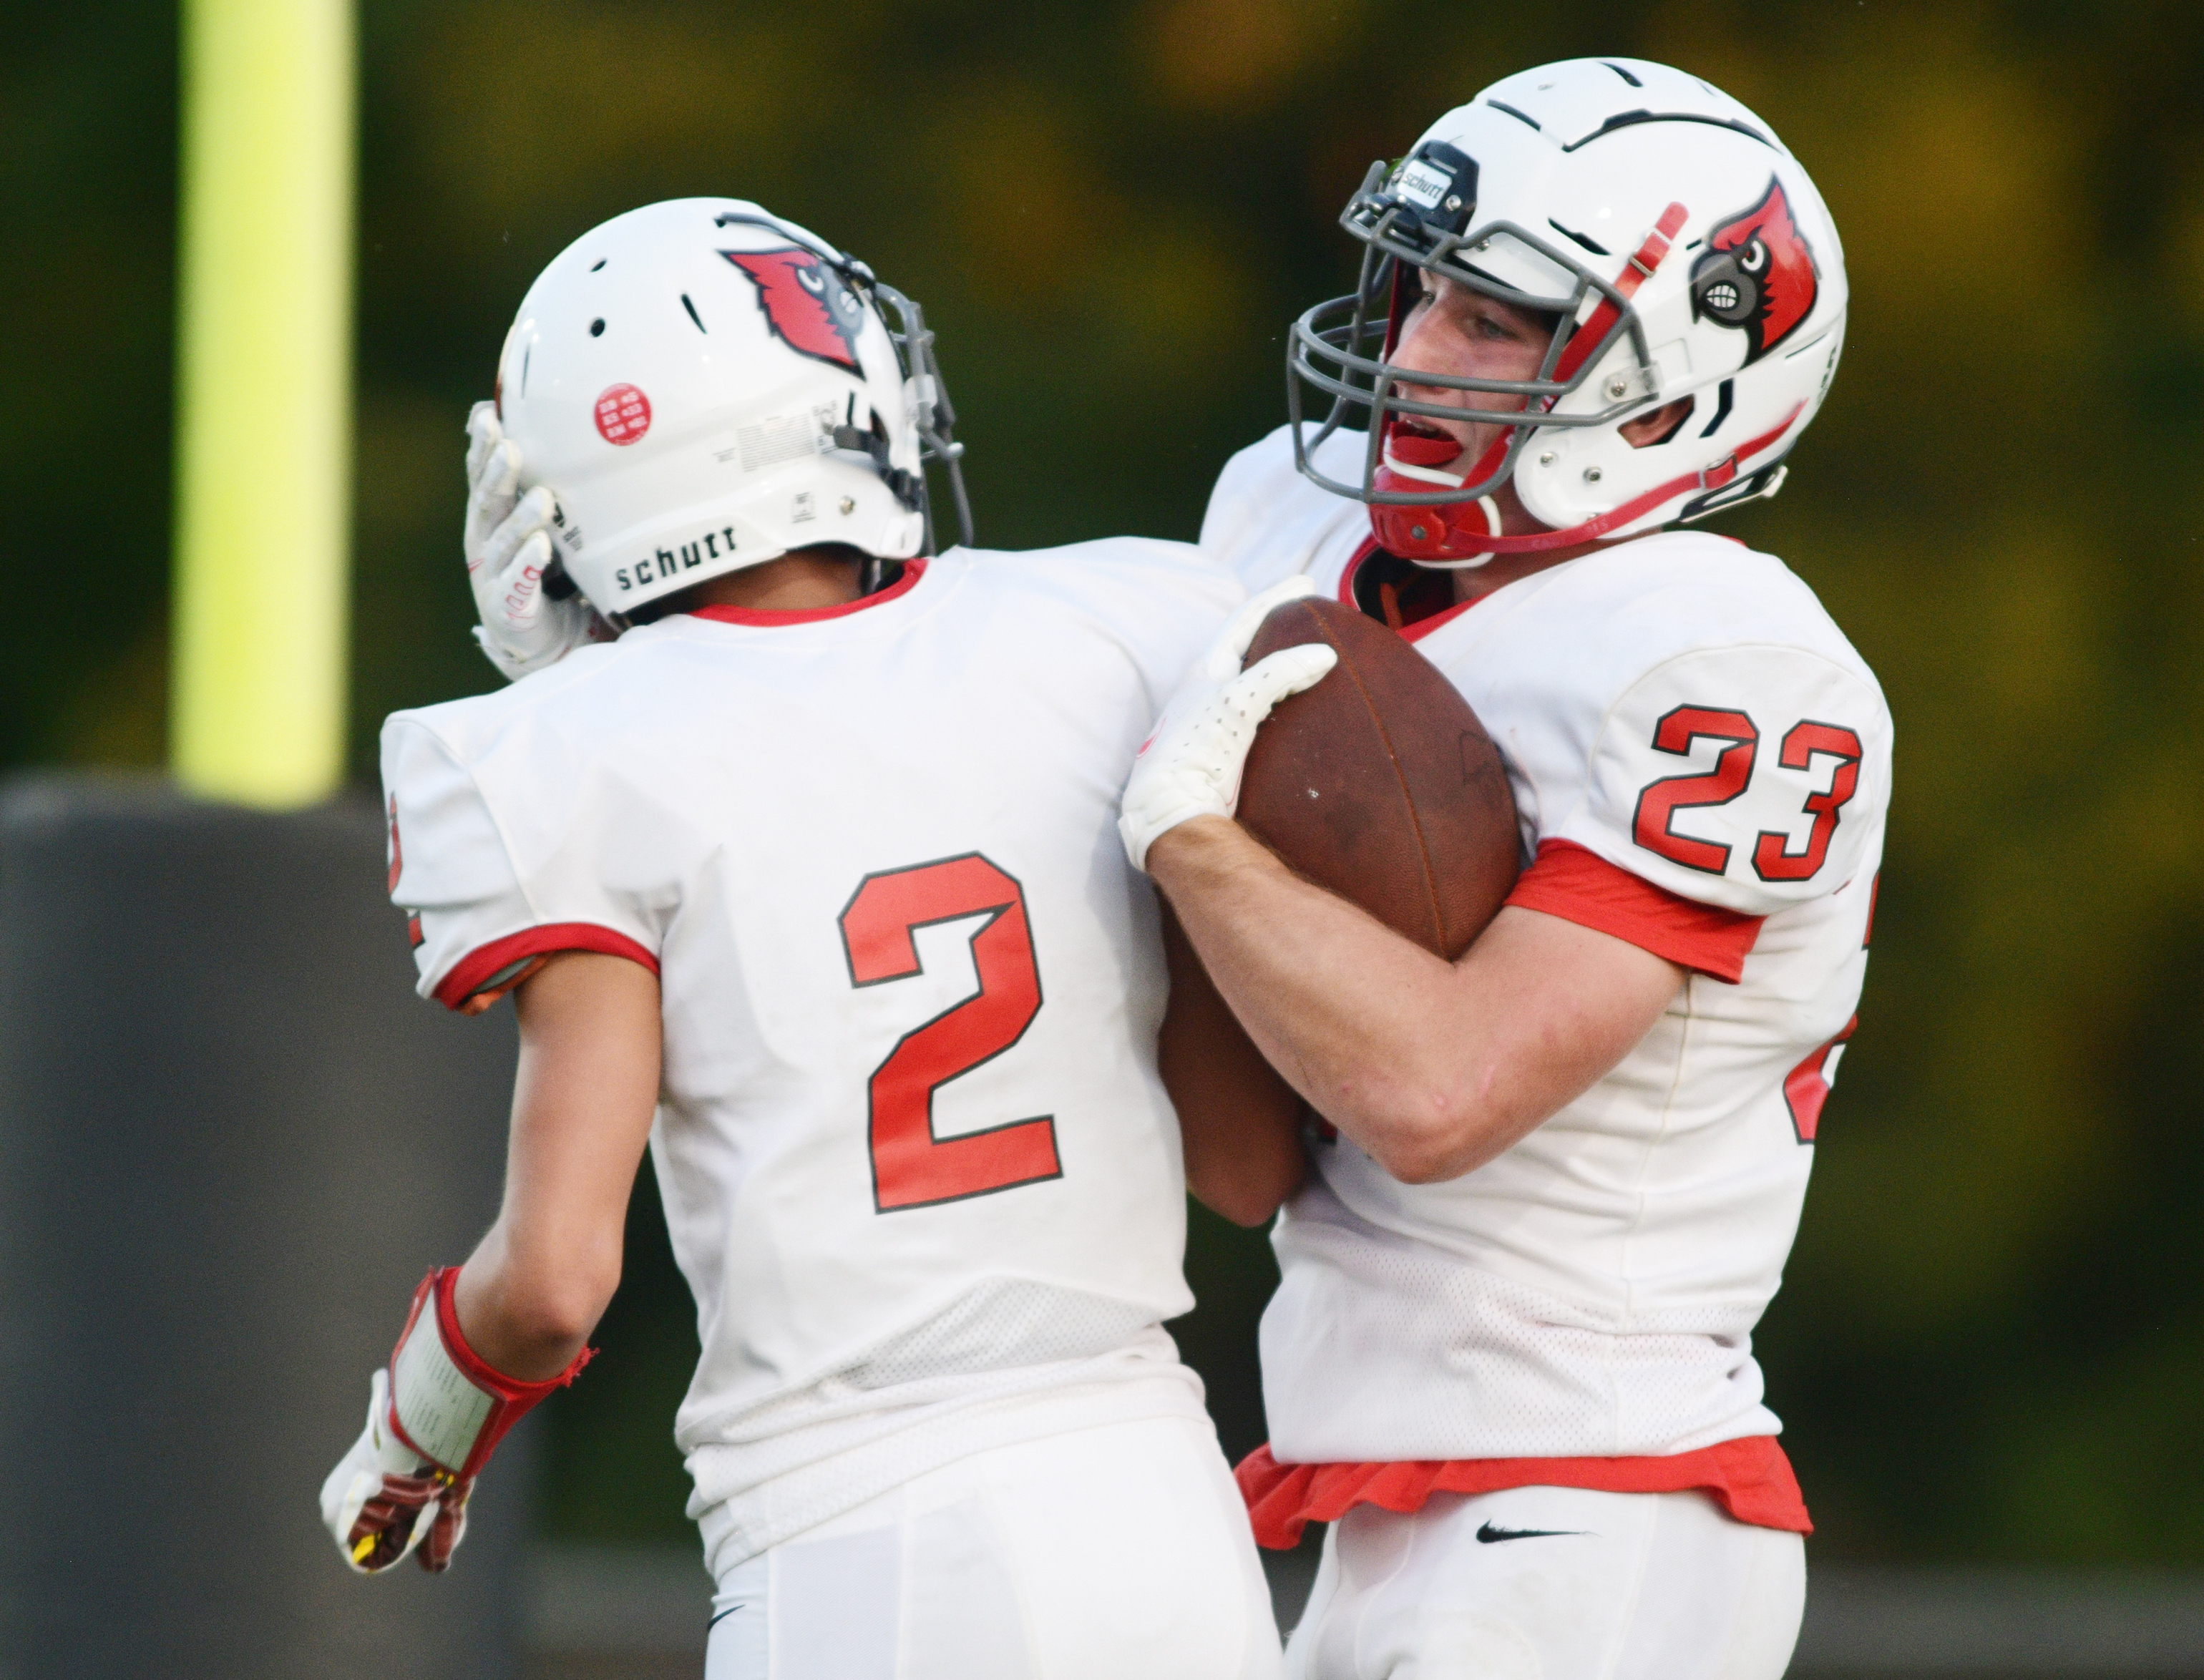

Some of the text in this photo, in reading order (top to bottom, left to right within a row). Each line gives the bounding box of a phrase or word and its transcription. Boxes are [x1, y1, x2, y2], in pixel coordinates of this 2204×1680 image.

[1403, 173, 1444, 199] schutt
[616, 527, 736, 591] schutt
[1632, 703, 1863, 881] 23
[837, 850, 1064, 1215] 2
